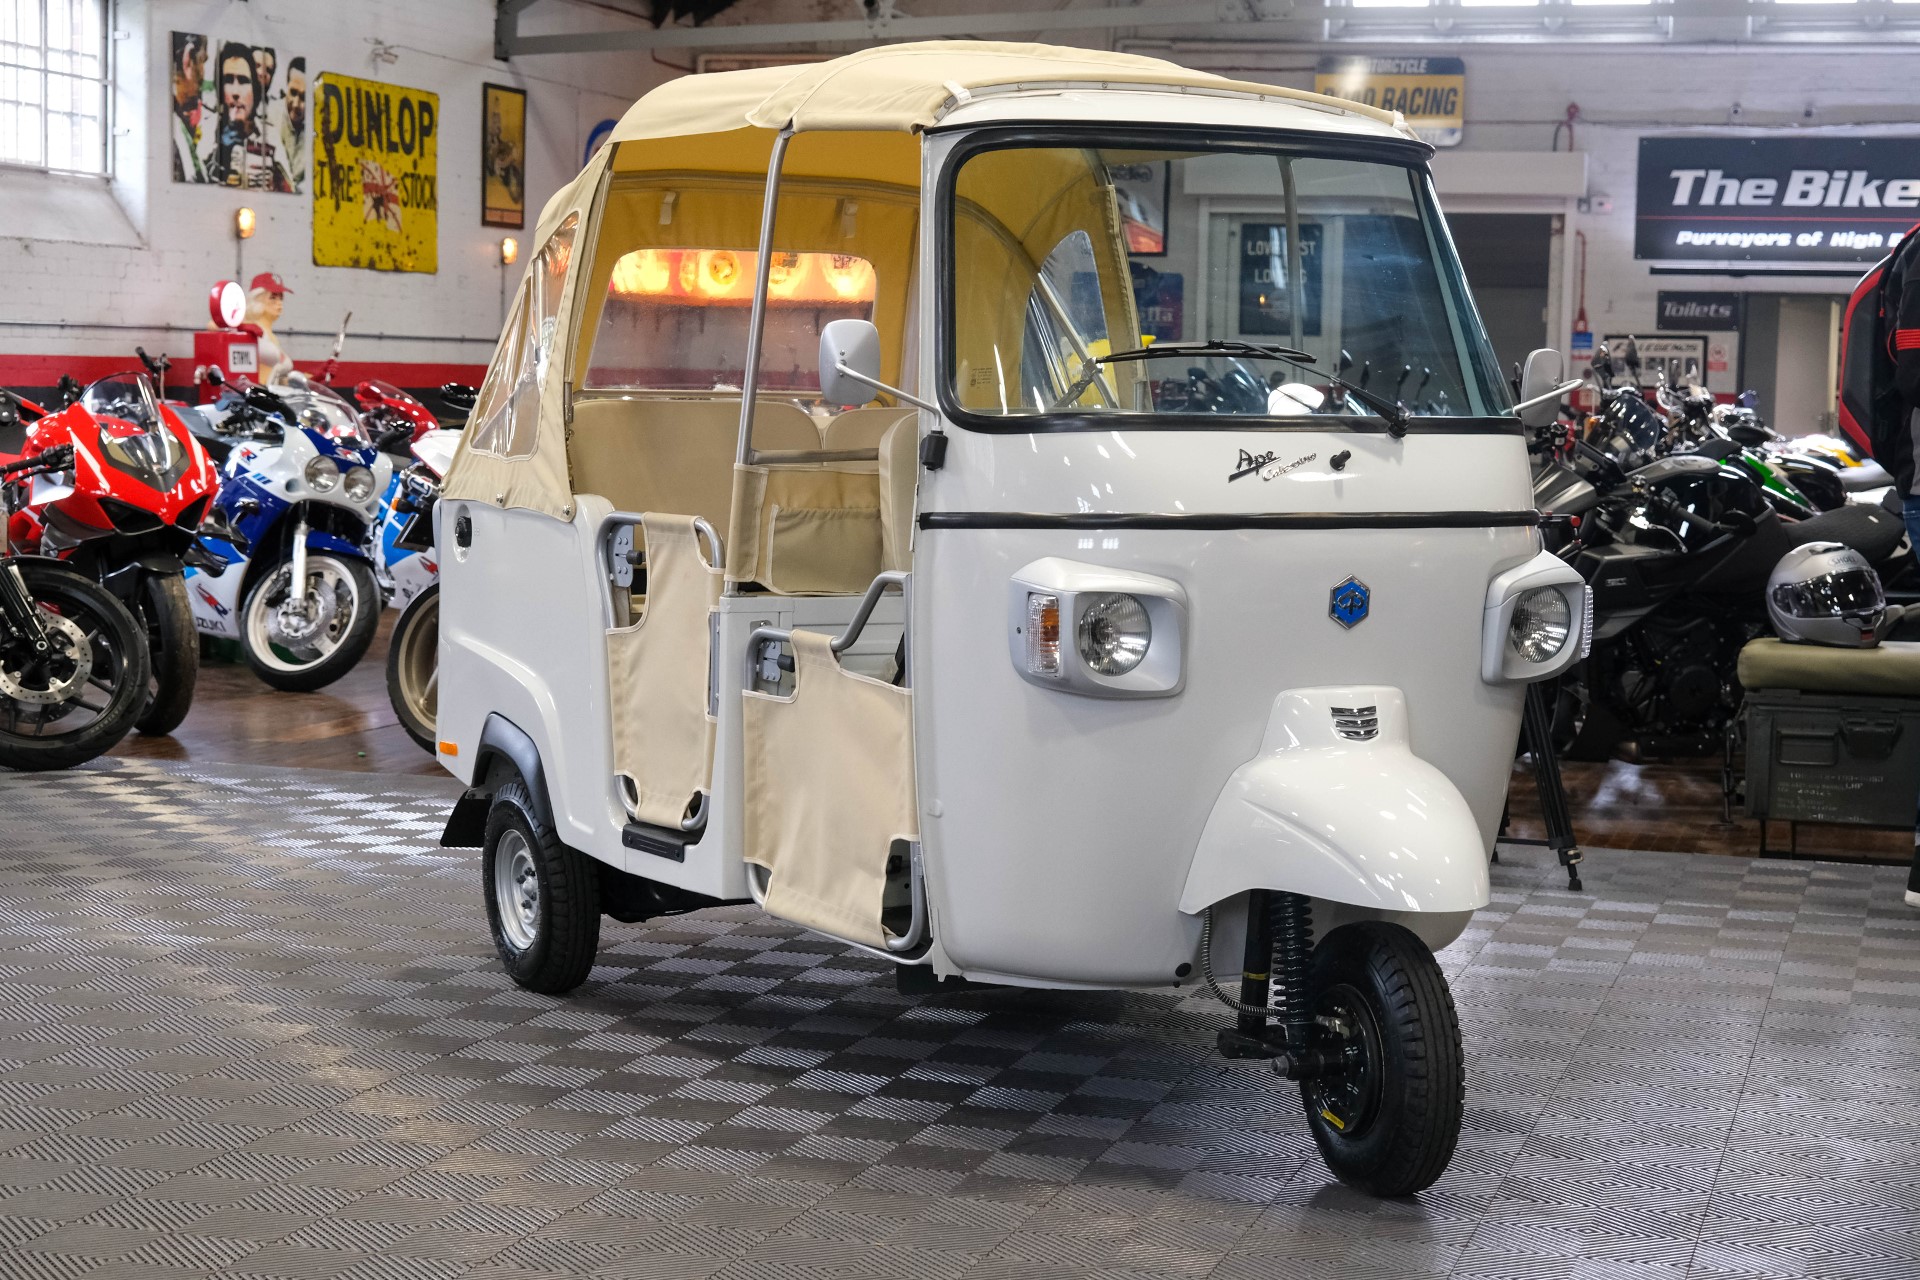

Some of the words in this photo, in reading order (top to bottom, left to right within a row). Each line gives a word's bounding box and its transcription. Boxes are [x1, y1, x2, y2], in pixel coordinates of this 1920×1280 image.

[1381, 87, 1458, 115] RACING
[323, 83, 435, 158] DUNLOP
[1670, 169, 1778, 206] The
[1782, 170, 1920, 207] Bike
[1676, 230, 1792, 248] Purveyors
[1796, 231, 1824, 247] of
[1829, 232, 1884, 250] High
[1663, 301, 1733, 318] Toilets
[232, 350, 253, 365] ETHYL
[1235, 448, 1278, 477] Ape
